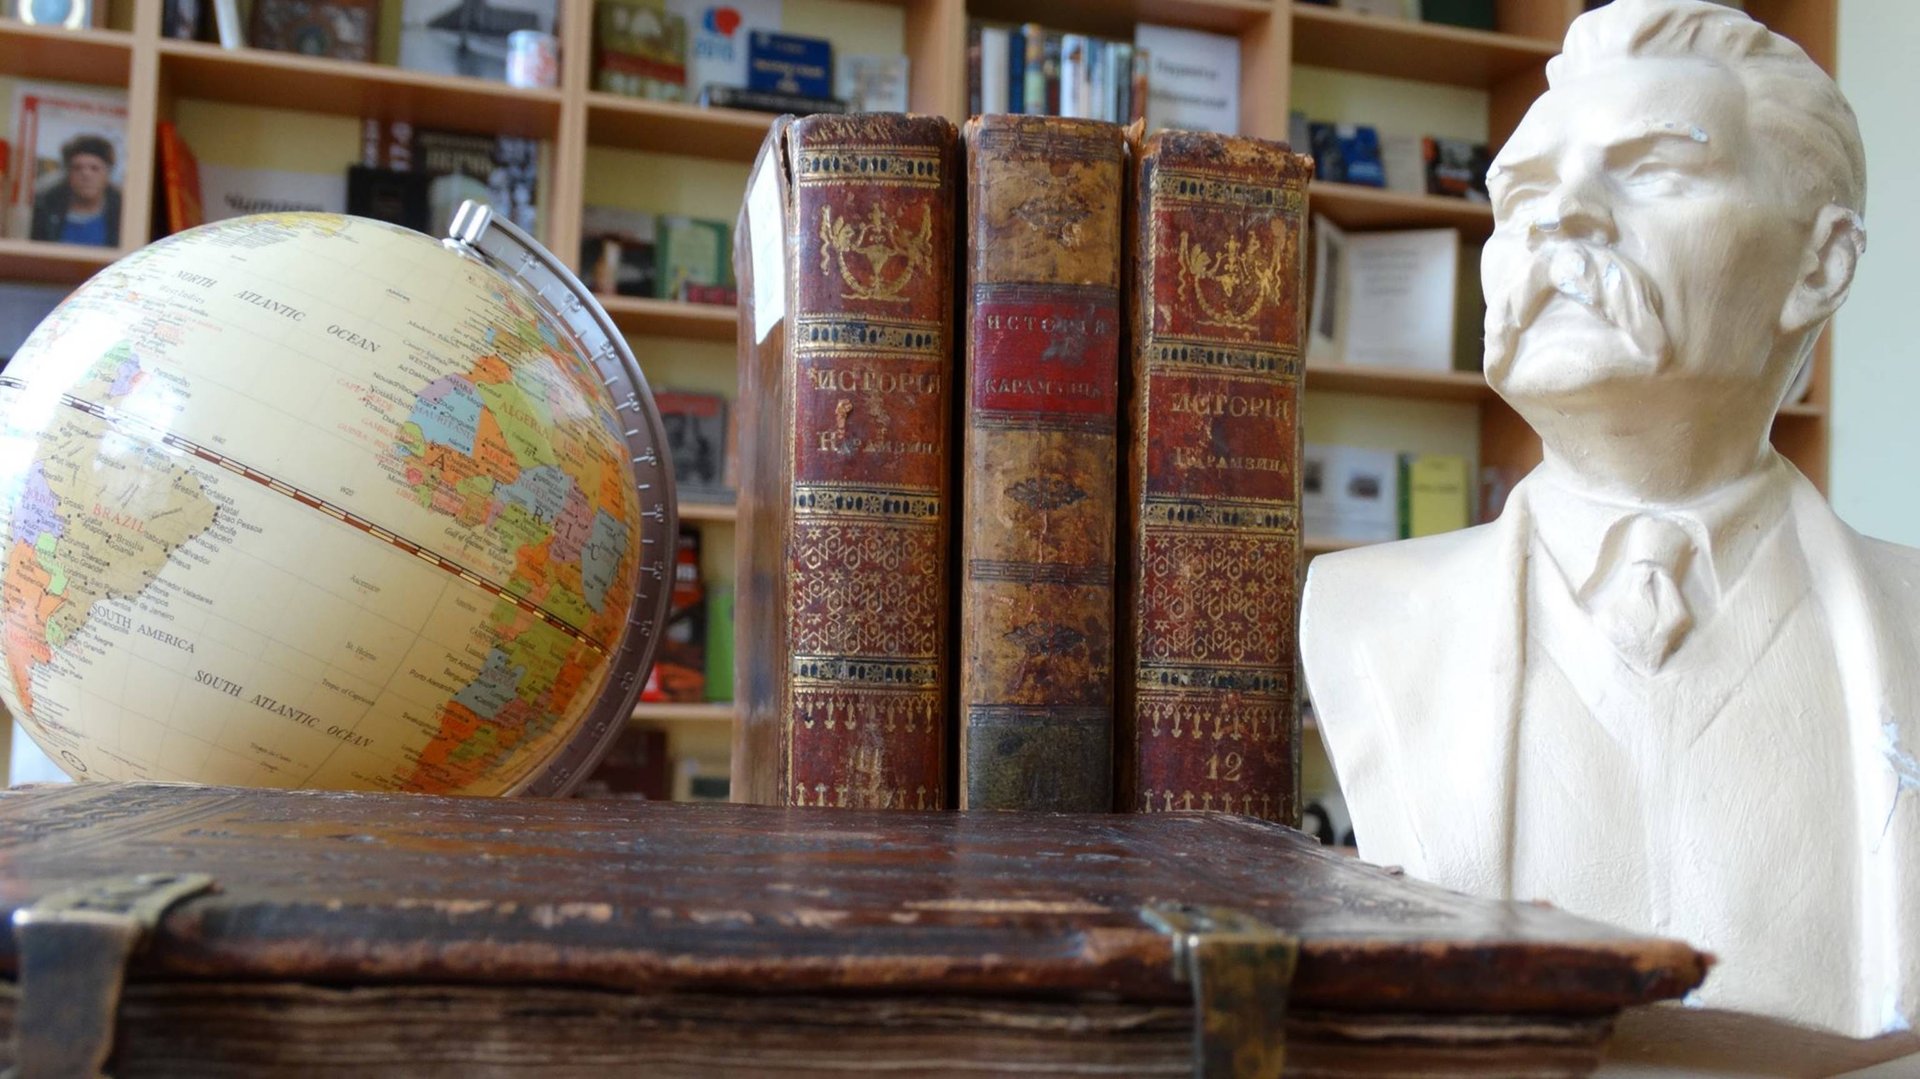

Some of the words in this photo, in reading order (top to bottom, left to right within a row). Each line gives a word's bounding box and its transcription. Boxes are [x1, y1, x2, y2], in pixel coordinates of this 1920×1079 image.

[172, 269, 219, 289] NORTH
[234, 289, 307, 323] ATLANTIC
[326, 324, 382, 354] OCEAN
[498, 400, 551, 442] ALGERIA
[92, 502, 146, 534] BRAZIL
[220, 502, 241, 517] Natal
[91, 602, 132, 630] SOUTH
[136, 622, 196, 655] AMERICA
[194, 669, 243, 698] SOUTH
[249, 693, 321, 729] ATLANTIC
[326, 725, 375, 749] OCEAN
[1204, 751, 1243, 782] 12
